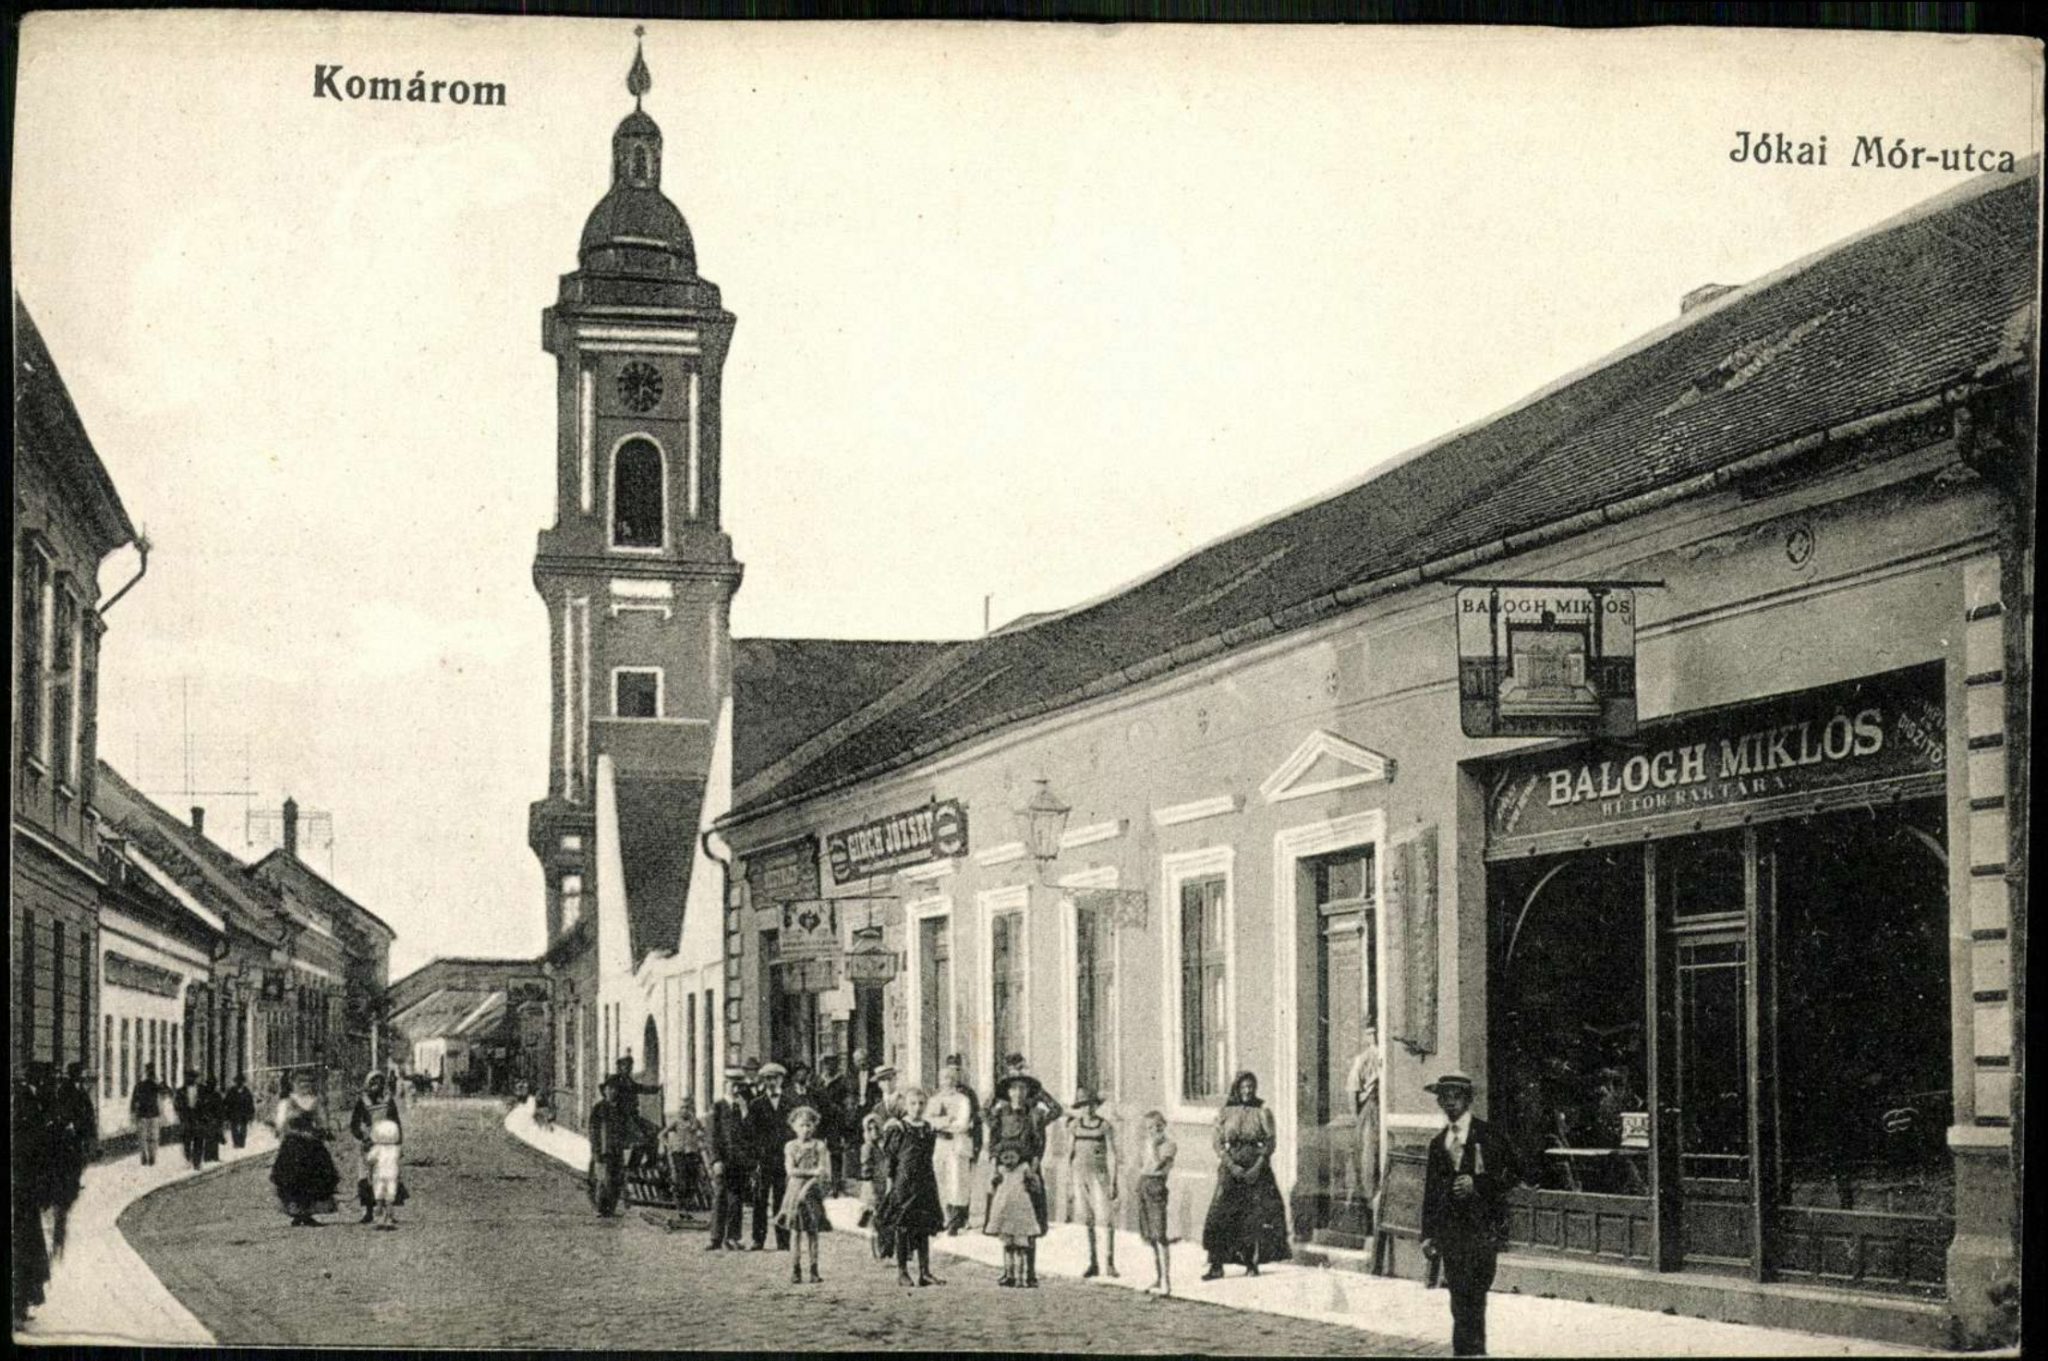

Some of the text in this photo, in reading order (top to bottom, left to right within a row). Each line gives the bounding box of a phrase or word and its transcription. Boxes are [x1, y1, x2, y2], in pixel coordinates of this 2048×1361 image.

[1462, 599, 1546, 614] BAOGH
[1547, 742, 1707, 808] BALOGH
[1719, 704, 1884, 779] MIKLÓS
